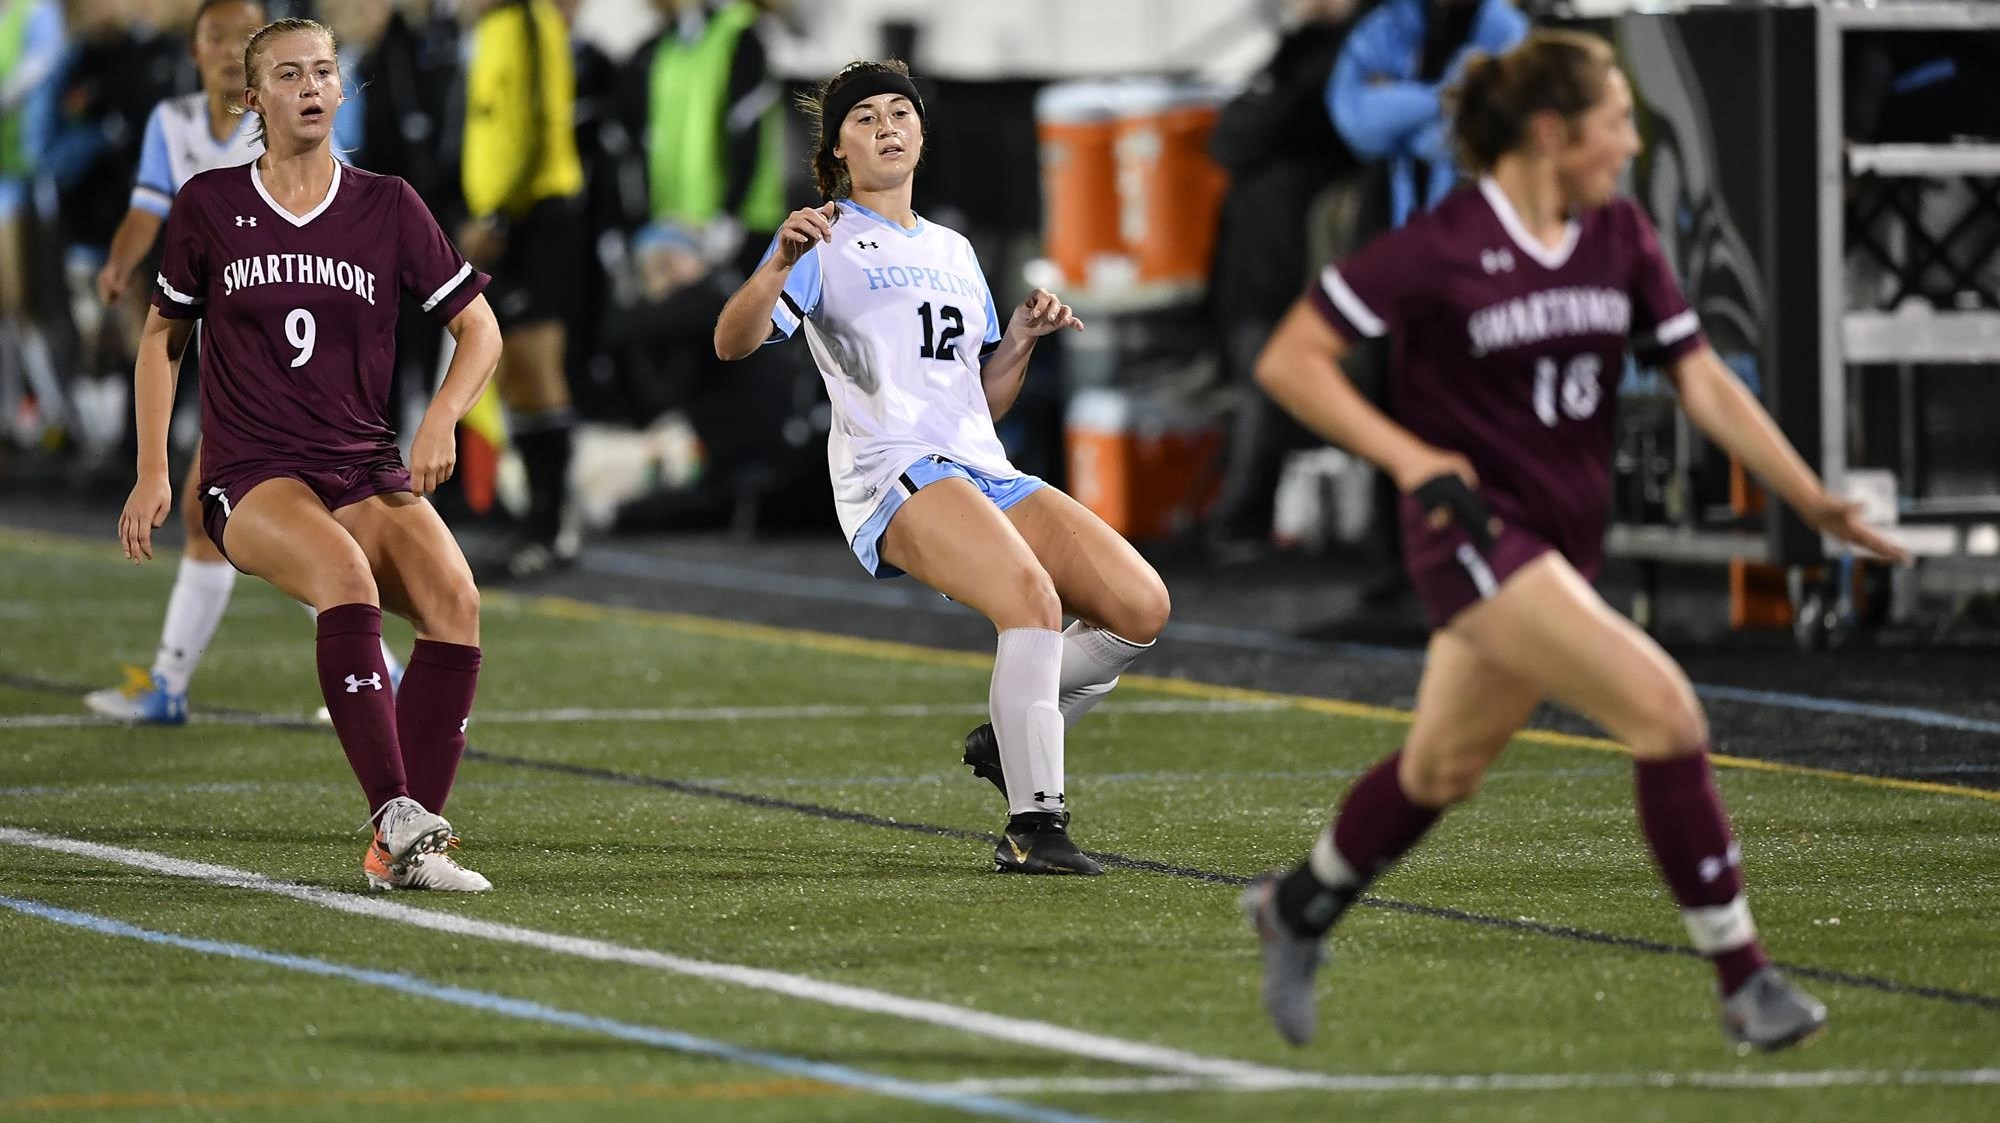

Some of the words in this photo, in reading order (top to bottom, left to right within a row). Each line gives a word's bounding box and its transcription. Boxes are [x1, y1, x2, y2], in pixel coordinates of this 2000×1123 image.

[223, 253, 376, 306] SWARTHMORE
[862, 265, 978, 300] HOPKIN
[284, 308, 316, 368] 9
[917, 301, 965, 361] 12
